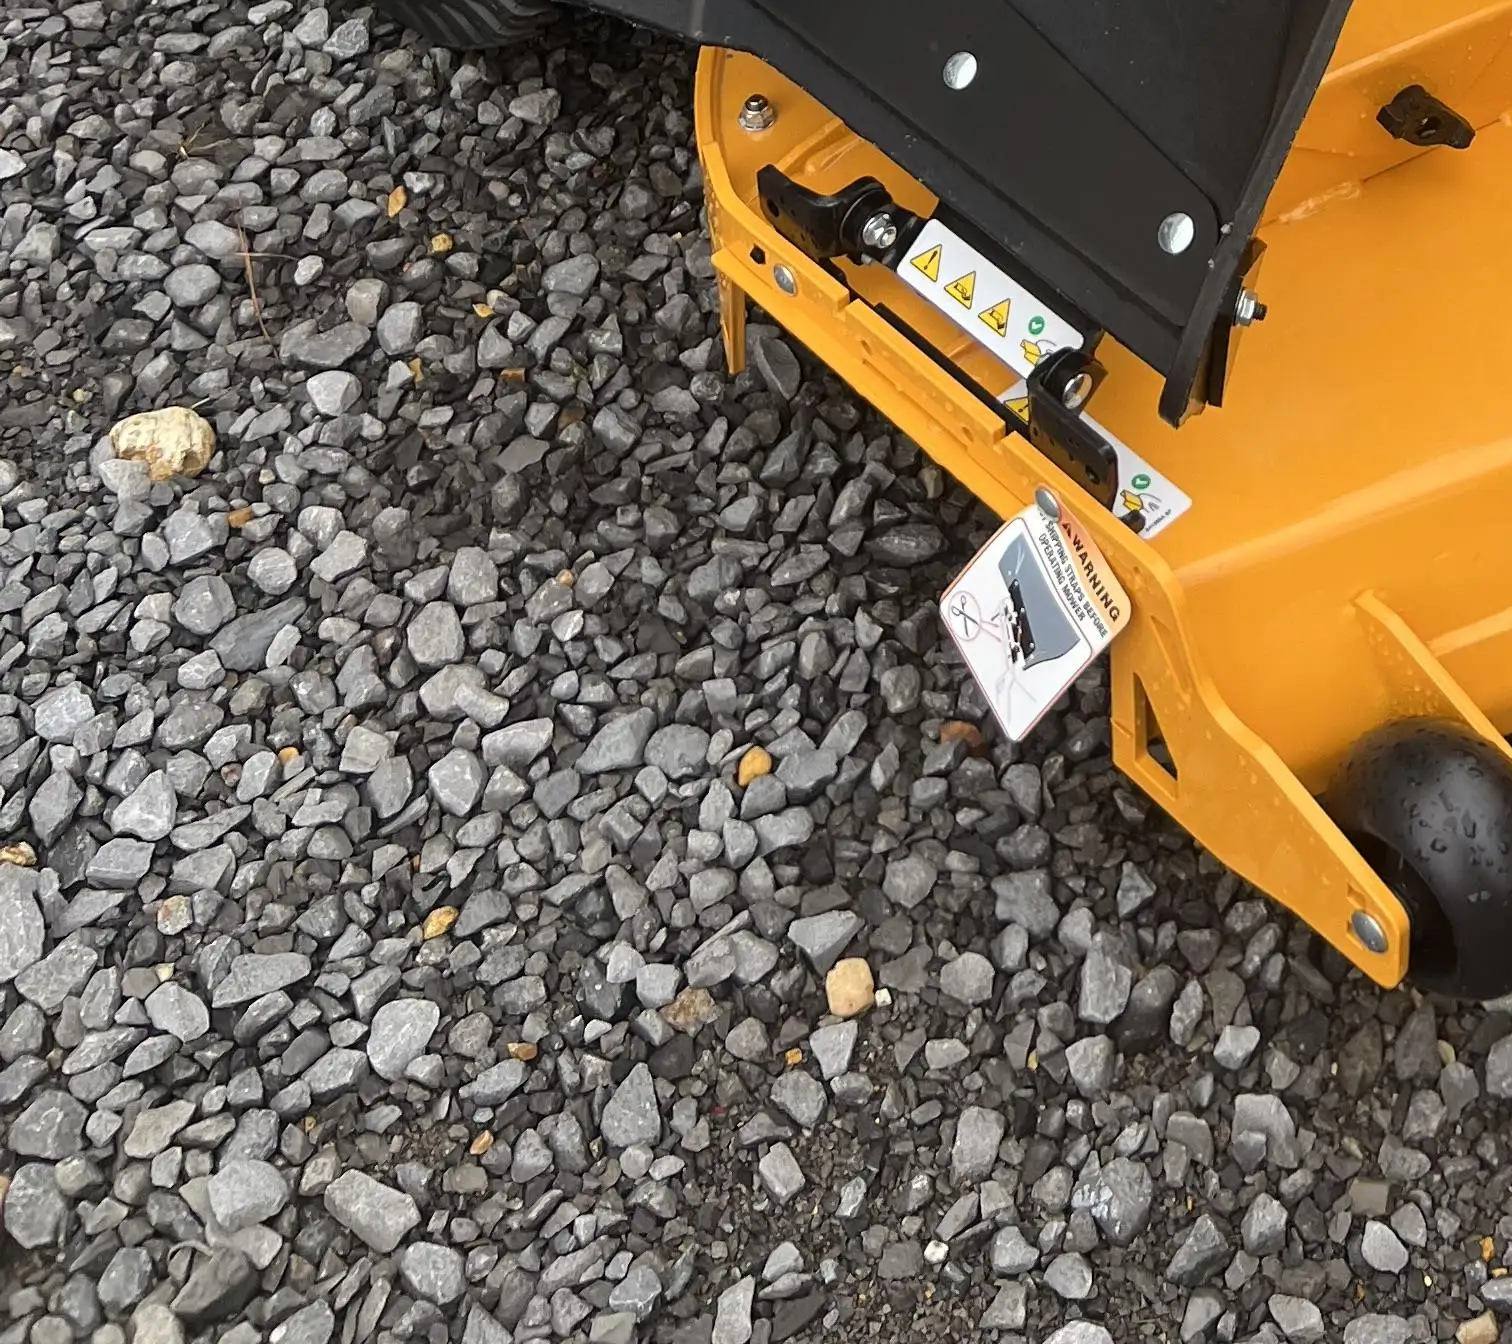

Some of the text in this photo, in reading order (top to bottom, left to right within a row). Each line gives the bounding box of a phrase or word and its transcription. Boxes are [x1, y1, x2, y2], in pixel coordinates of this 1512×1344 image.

[1038, 533, 1086, 622] OPERATING MOWER
[1045, 520, 1109, 639] SHIPPING STRAPS BEFORE
[1072, 534, 1121, 623] WARNING
